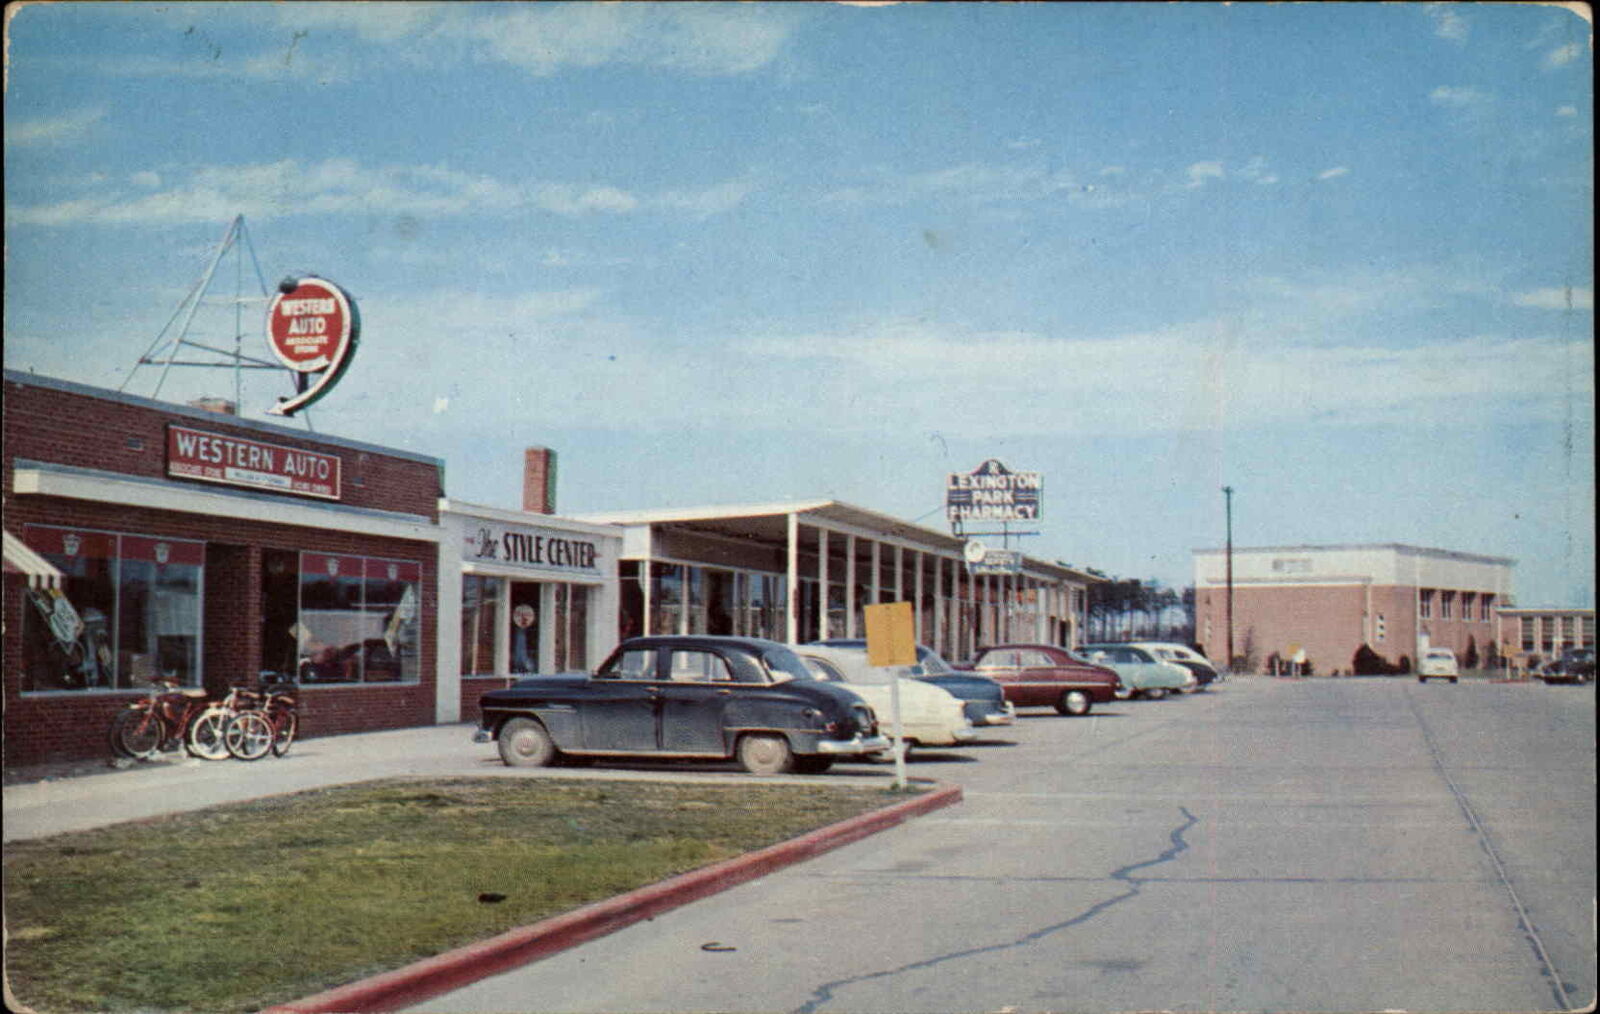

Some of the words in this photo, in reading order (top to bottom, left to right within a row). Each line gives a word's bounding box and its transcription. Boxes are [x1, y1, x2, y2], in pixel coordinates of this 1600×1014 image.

[280, 298, 336, 316] WESTERN
[288, 317, 327, 335] AUTO
[176, 432, 273, 471] WESTERN
[284, 453, 330, 480] AUTO
[947, 474, 1040, 490] LEXINGTON
[972, 489, 1015, 504] PARK
[948, 504, 1036, 521] PHARMACY
[475, 527, 500, 560] The
[502, 532, 544, 564] STYLE
[546, 538, 596, 568] CENTER
